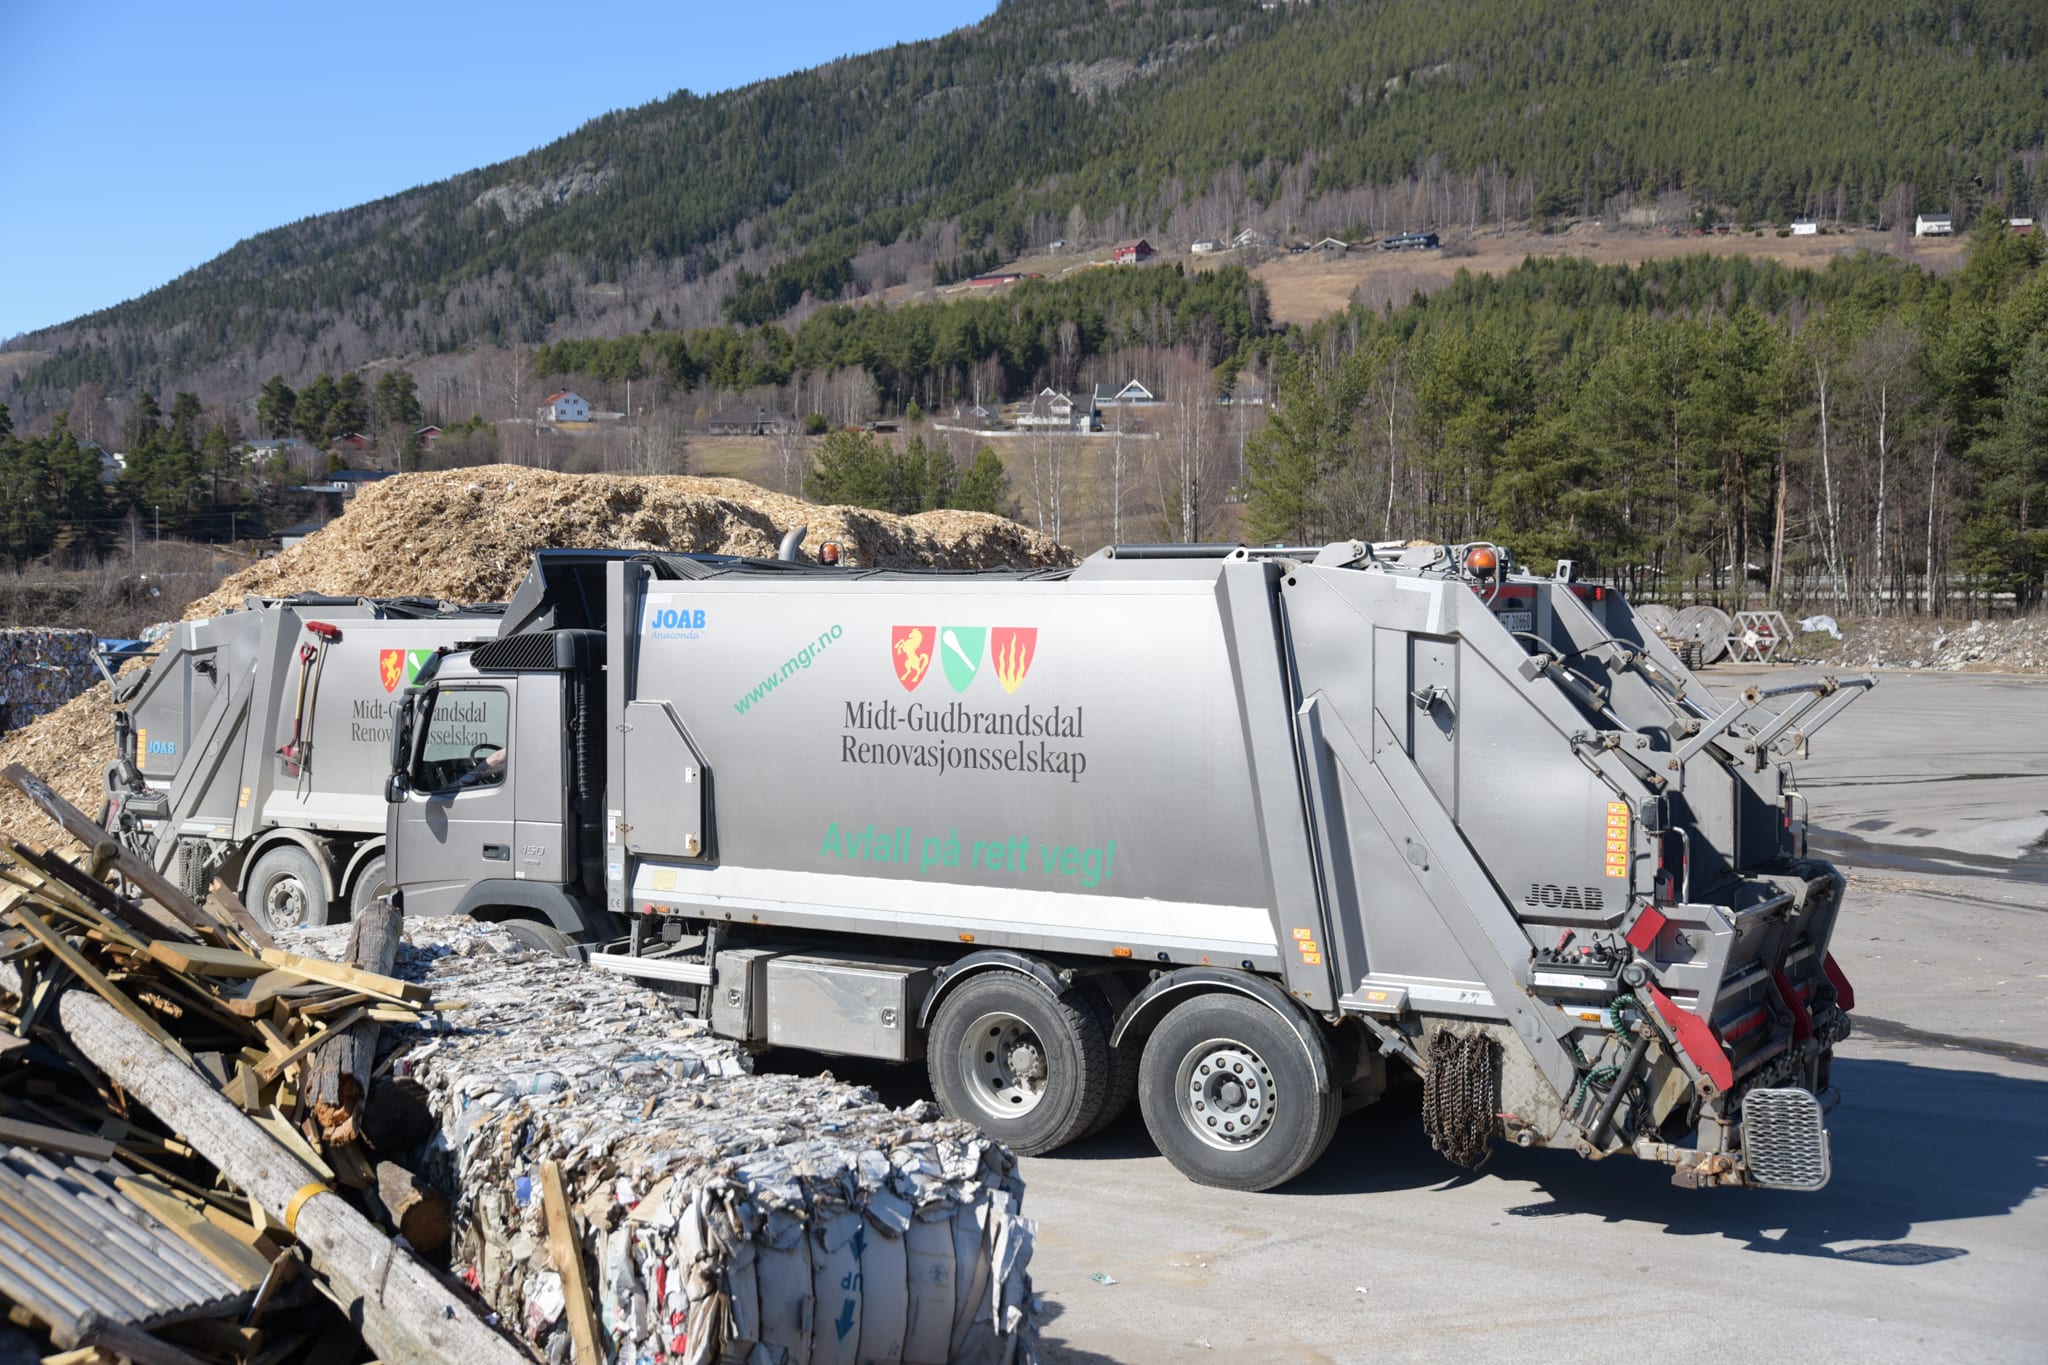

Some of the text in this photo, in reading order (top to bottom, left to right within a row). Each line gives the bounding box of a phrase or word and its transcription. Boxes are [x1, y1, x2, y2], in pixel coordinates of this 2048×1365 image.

[652, 609, 706, 629] JOAB
[733, 624, 843, 715] www.mgr.no
[843, 699, 1085, 738] Midt-Gudbrandsdal
[147, 740, 176, 755] JOAB
[841, 735, 1087, 783] Renovasjonsselskap
[819, 821, 1117, 888] Avfall på rett veg!
[1525, 883, 1604, 911] JOAB
